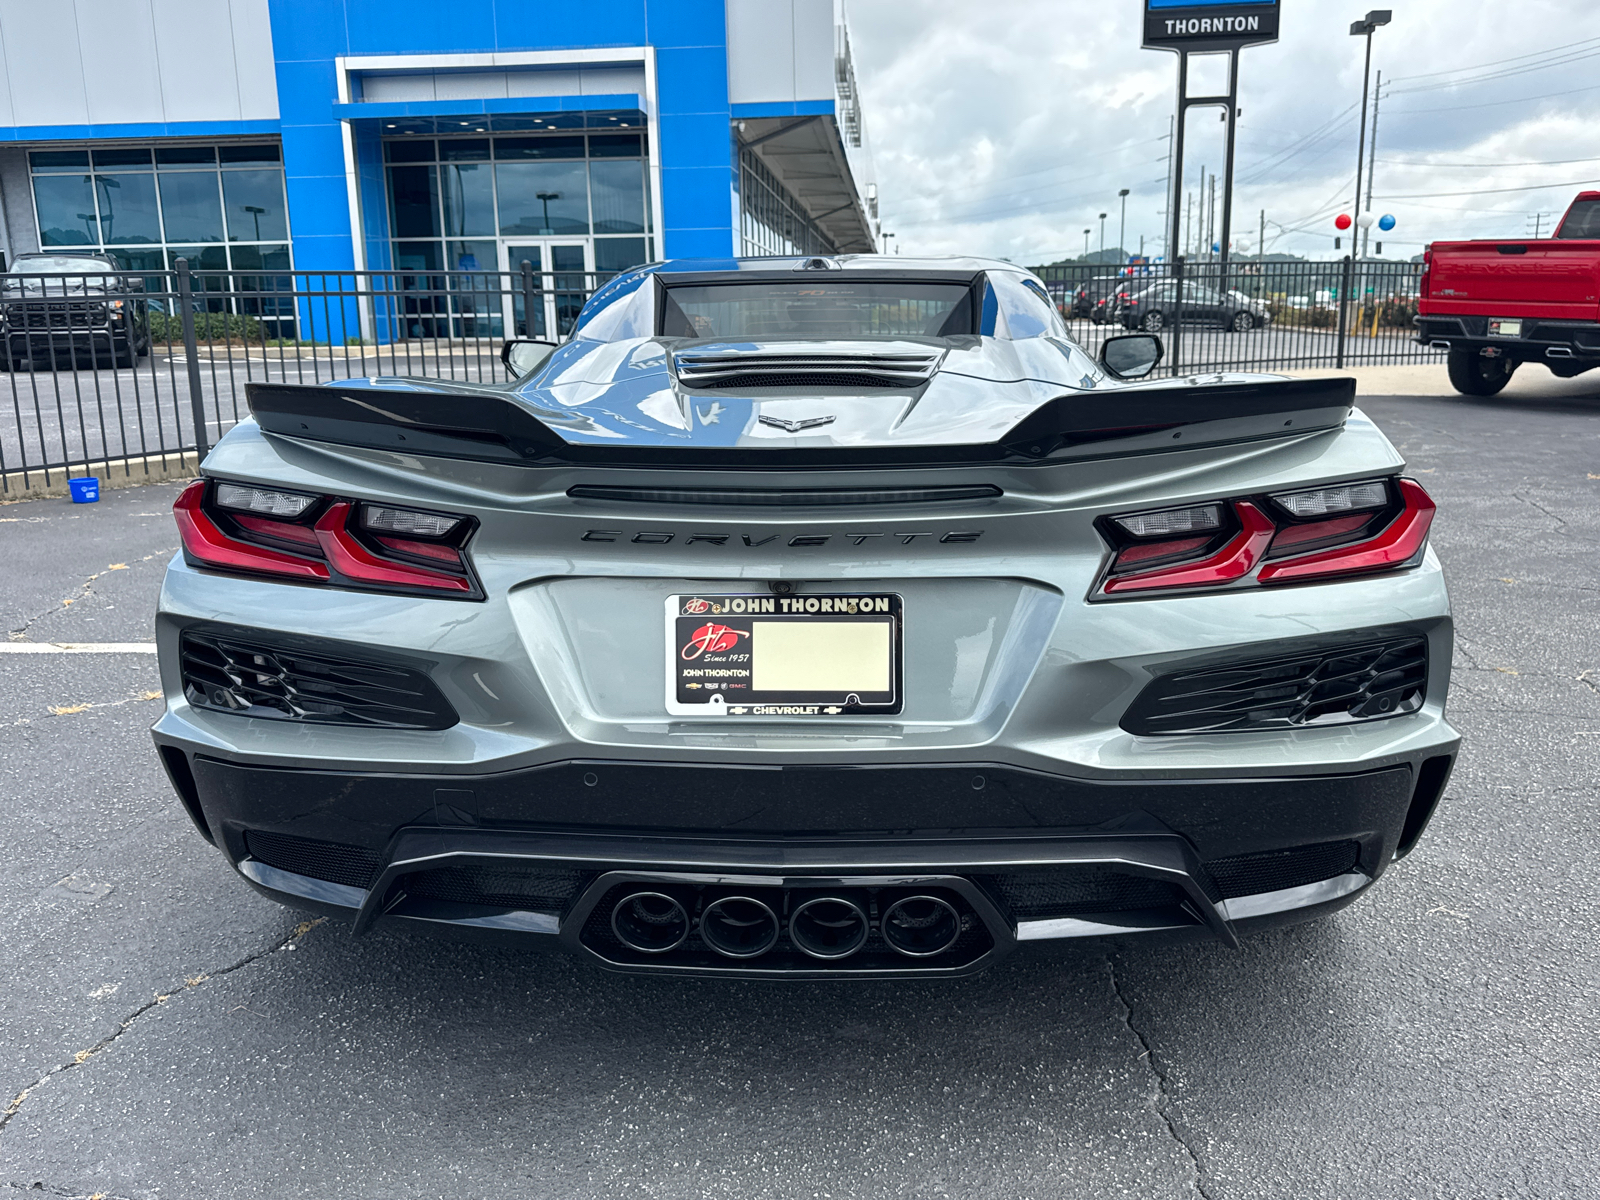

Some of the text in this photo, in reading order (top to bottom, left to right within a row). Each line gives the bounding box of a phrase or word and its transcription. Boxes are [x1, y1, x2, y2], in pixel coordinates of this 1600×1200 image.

[1165, 16, 1259, 35] THORNTON
[580, 529, 986, 548] CORVETTE
[721, 597, 890, 613] JOHN THORNTON
[704, 654, 750, 662] Since 1957
[683, 668, 750, 677] JOHN THORNTON
[752, 705, 820, 715] CHEVROLET
